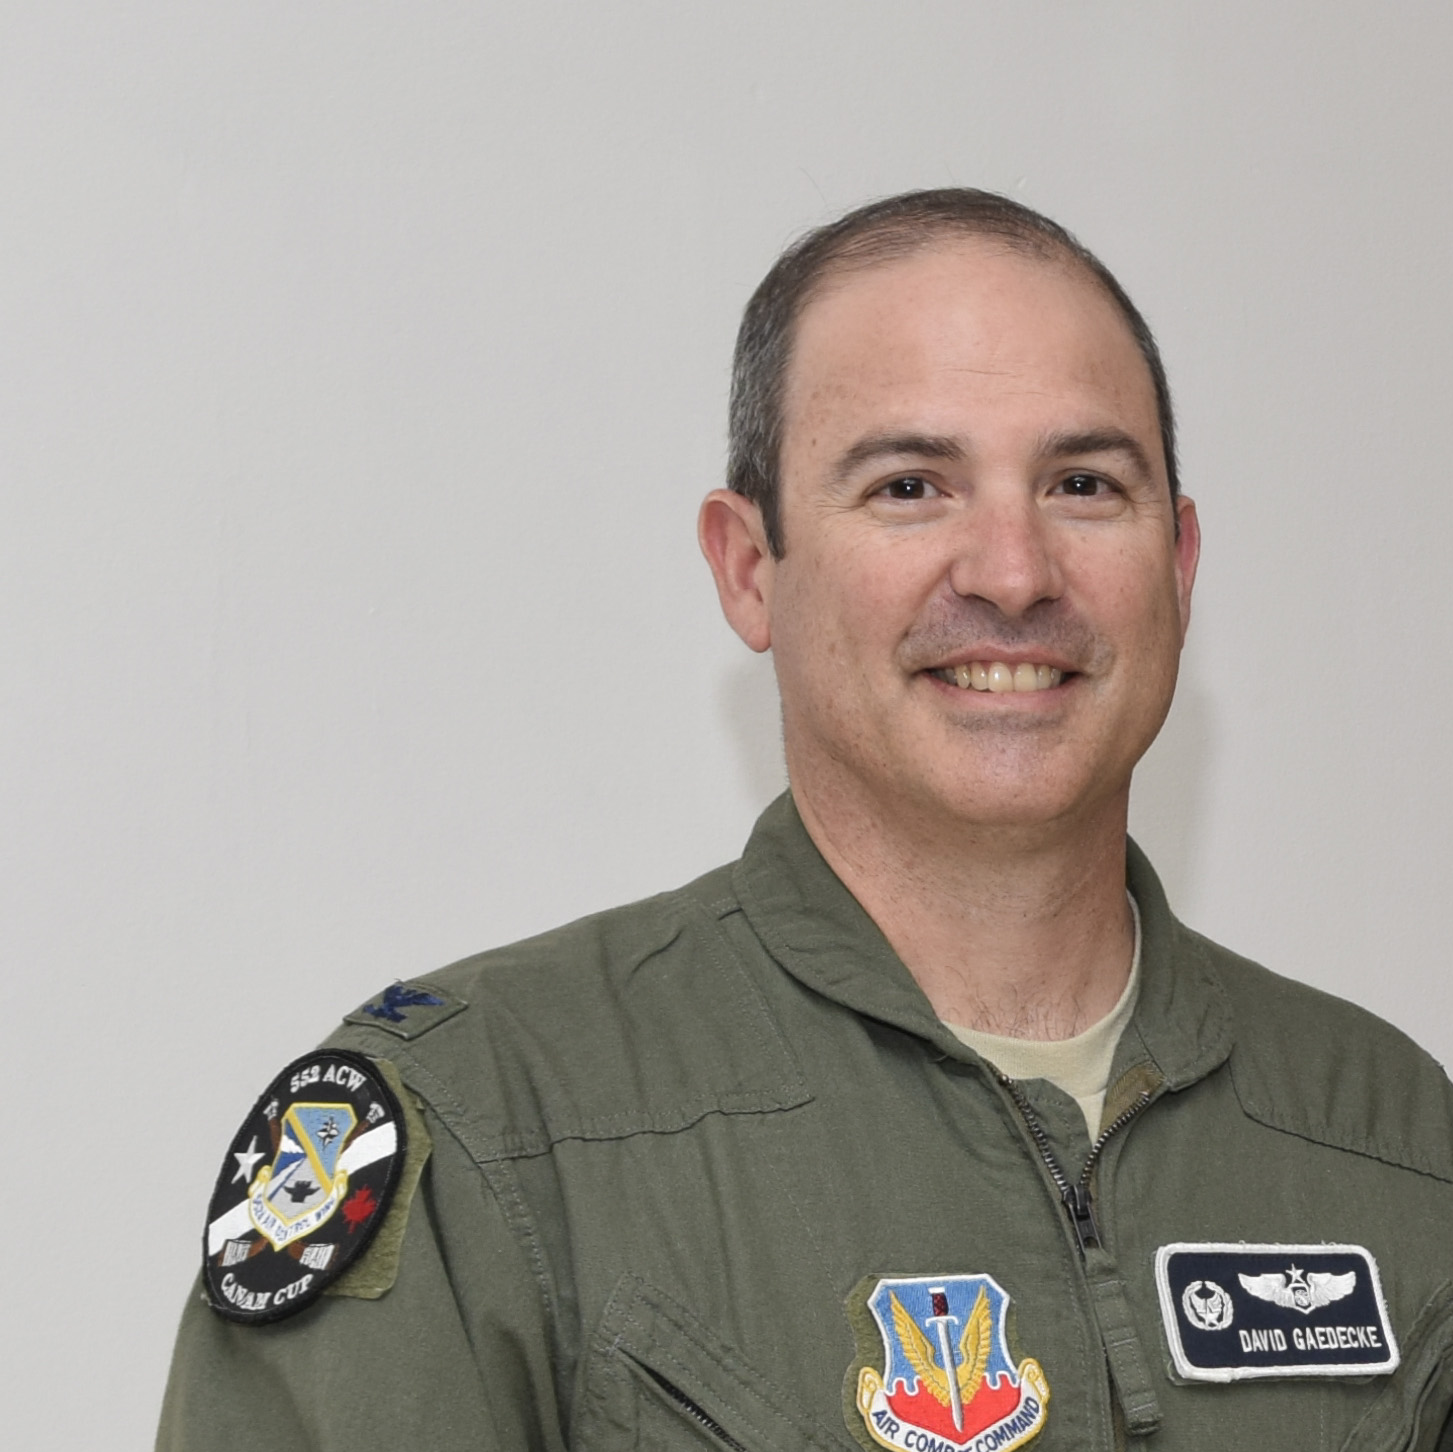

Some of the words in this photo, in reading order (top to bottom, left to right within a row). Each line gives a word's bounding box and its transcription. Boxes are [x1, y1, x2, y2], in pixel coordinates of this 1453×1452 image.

[290, 1064, 321, 1093] 552
[322, 1063, 367, 1092] ACW
[221, 1272, 272, 1310] CANAM
[273, 1274, 313, 1305] CUP
[1238, 1327, 1288, 1353] DAVID
[1294, 1325, 1382, 1352] GAEDECKE
[873, 1408, 899, 1436] AIR
